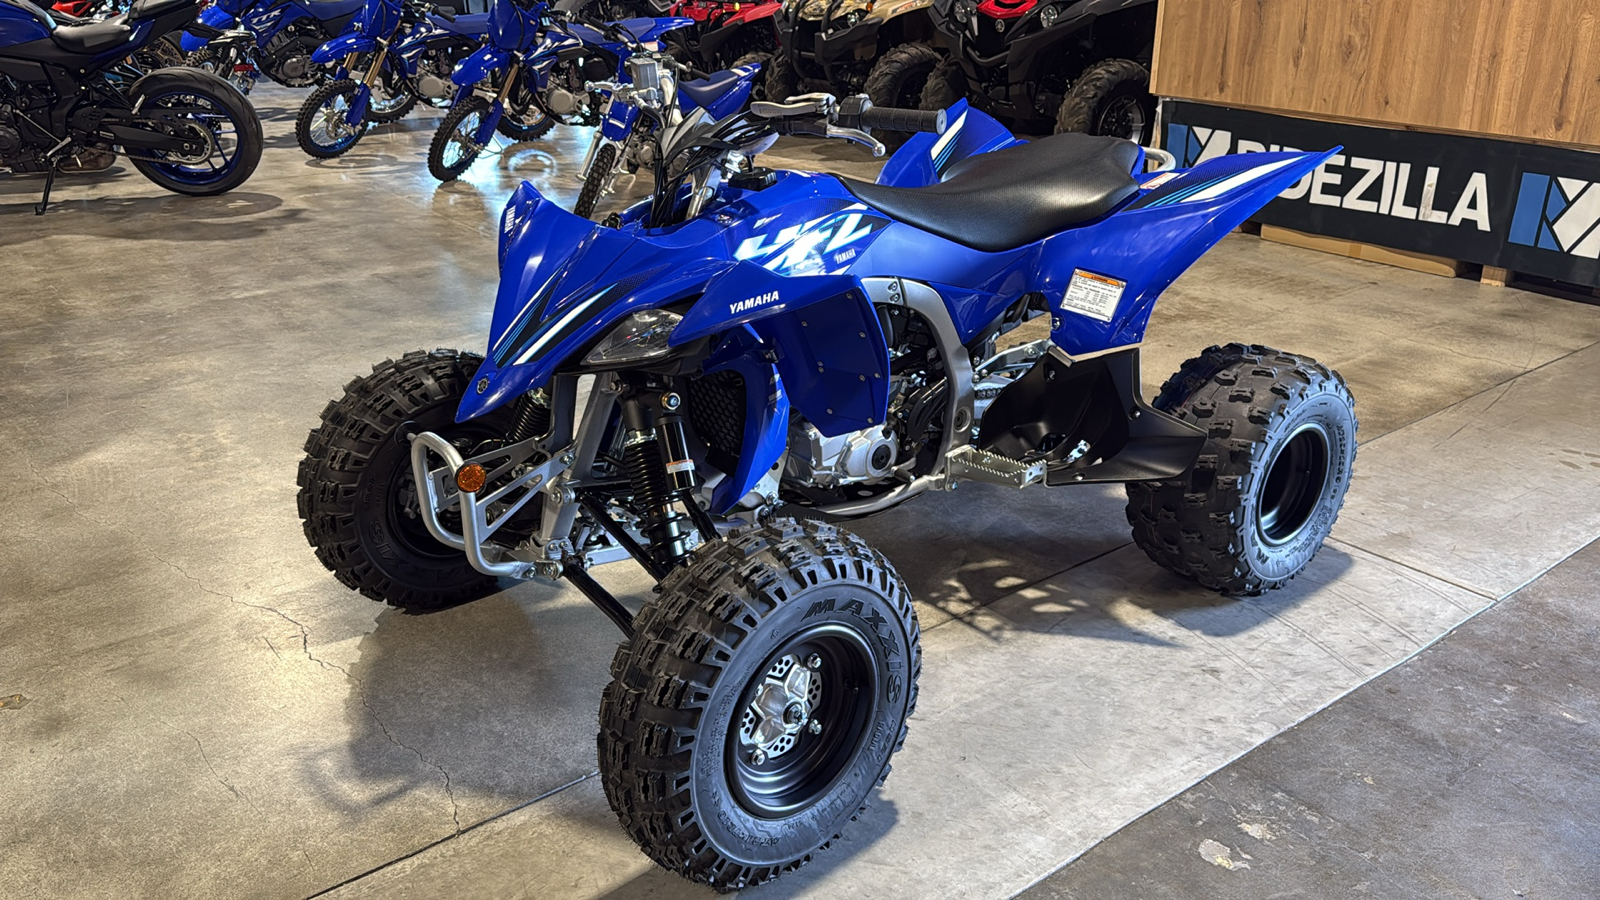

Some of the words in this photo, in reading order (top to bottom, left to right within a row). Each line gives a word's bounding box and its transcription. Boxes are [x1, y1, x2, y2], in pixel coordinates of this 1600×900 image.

[504, 205, 516, 234] YAMAHA
[729, 290, 779, 314] YAMAHA
[801, 598, 902, 703] MAXXIS
